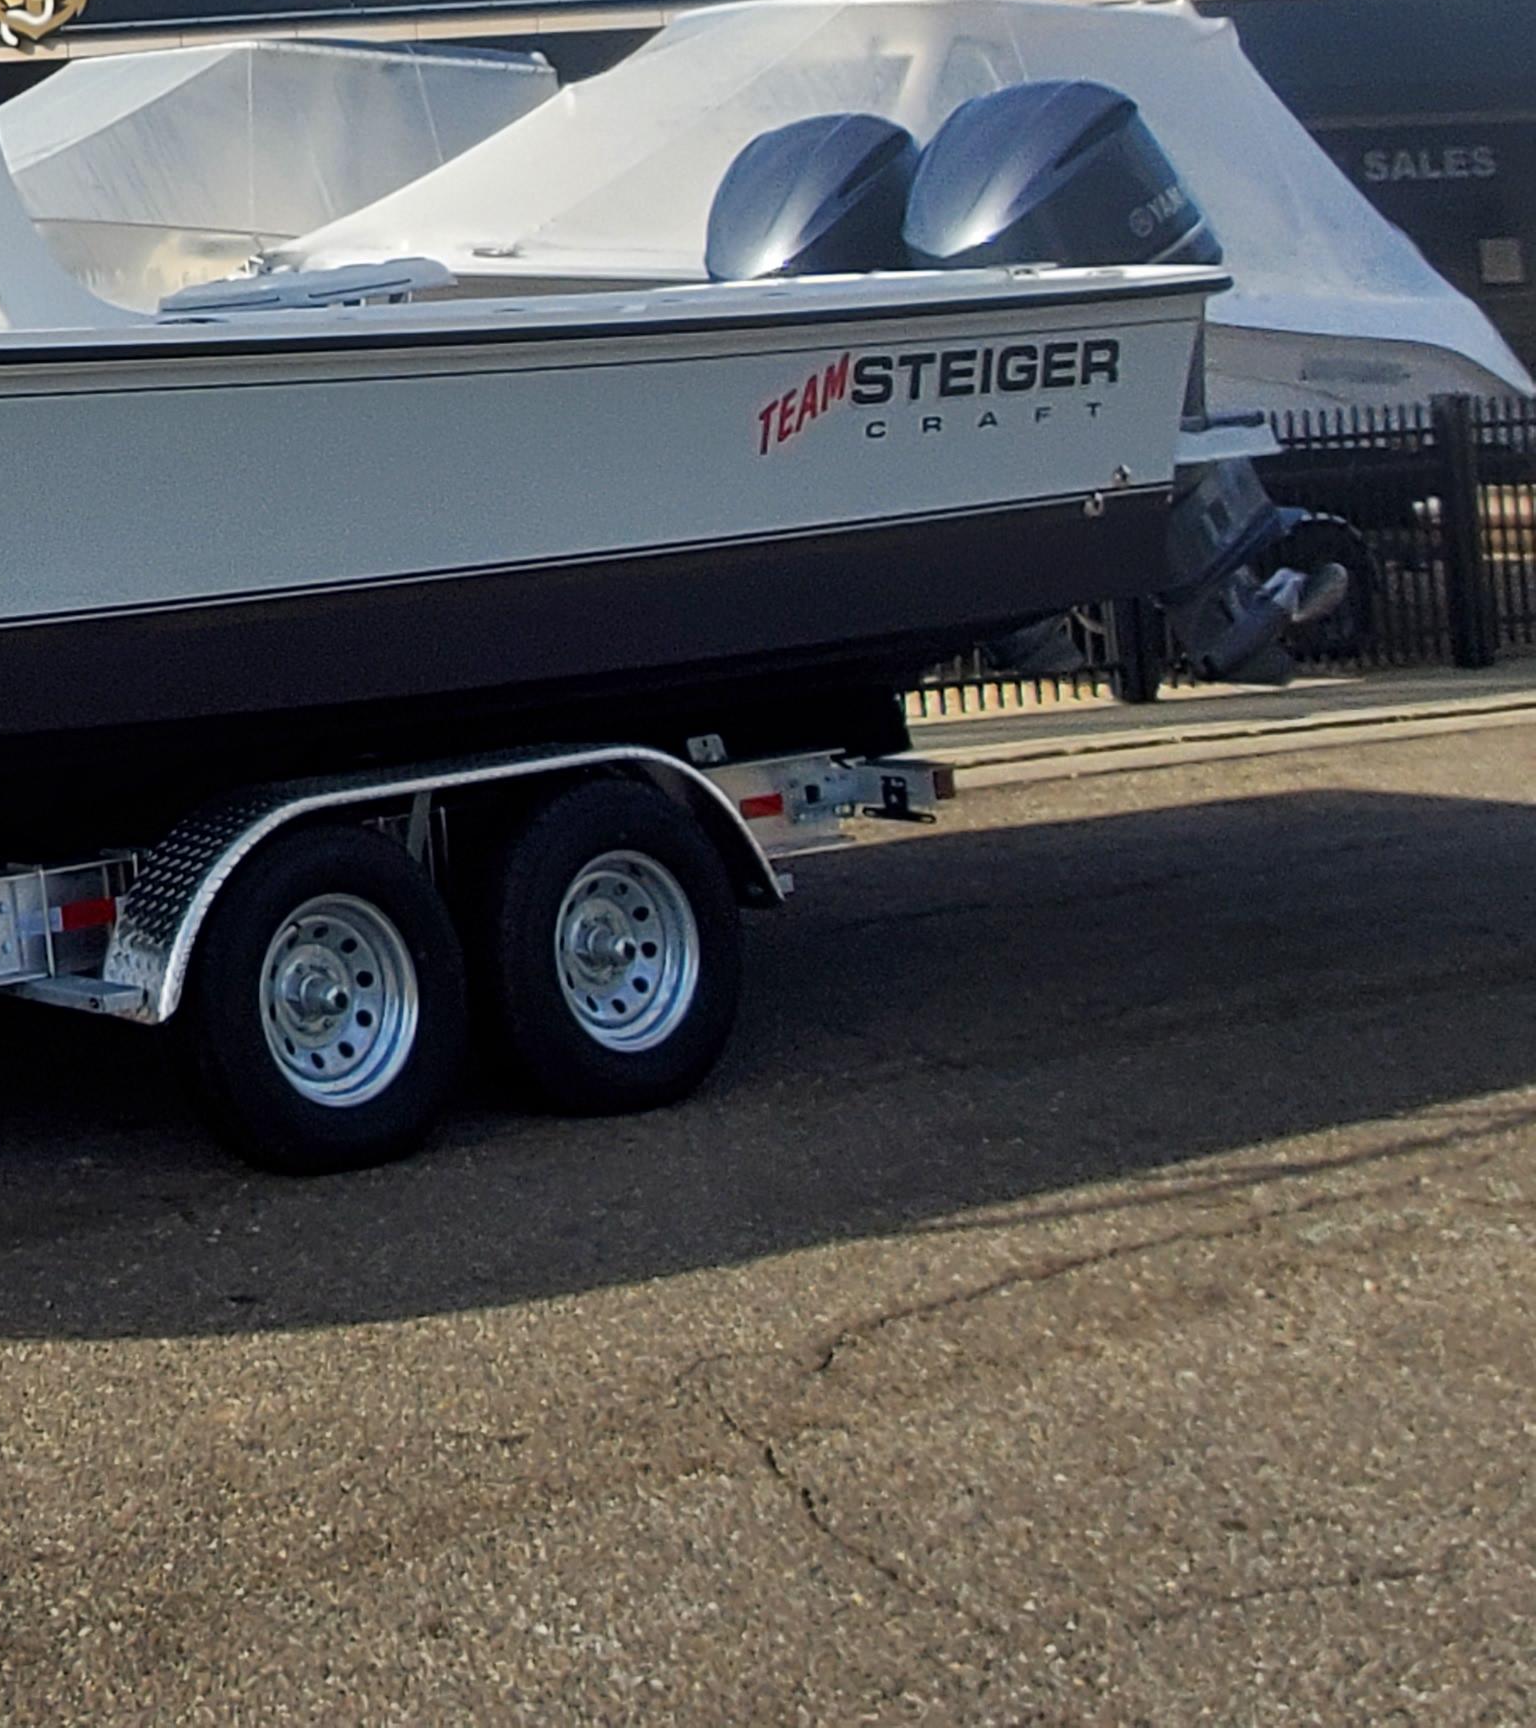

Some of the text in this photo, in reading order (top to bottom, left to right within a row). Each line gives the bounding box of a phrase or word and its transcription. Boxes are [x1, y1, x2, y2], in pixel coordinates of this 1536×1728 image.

[1363, 146, 1496, 181] SALES
[759, 338, 1120, 455] TEAM STEIGER
[866, 402, 1102, 439] CRAFT
